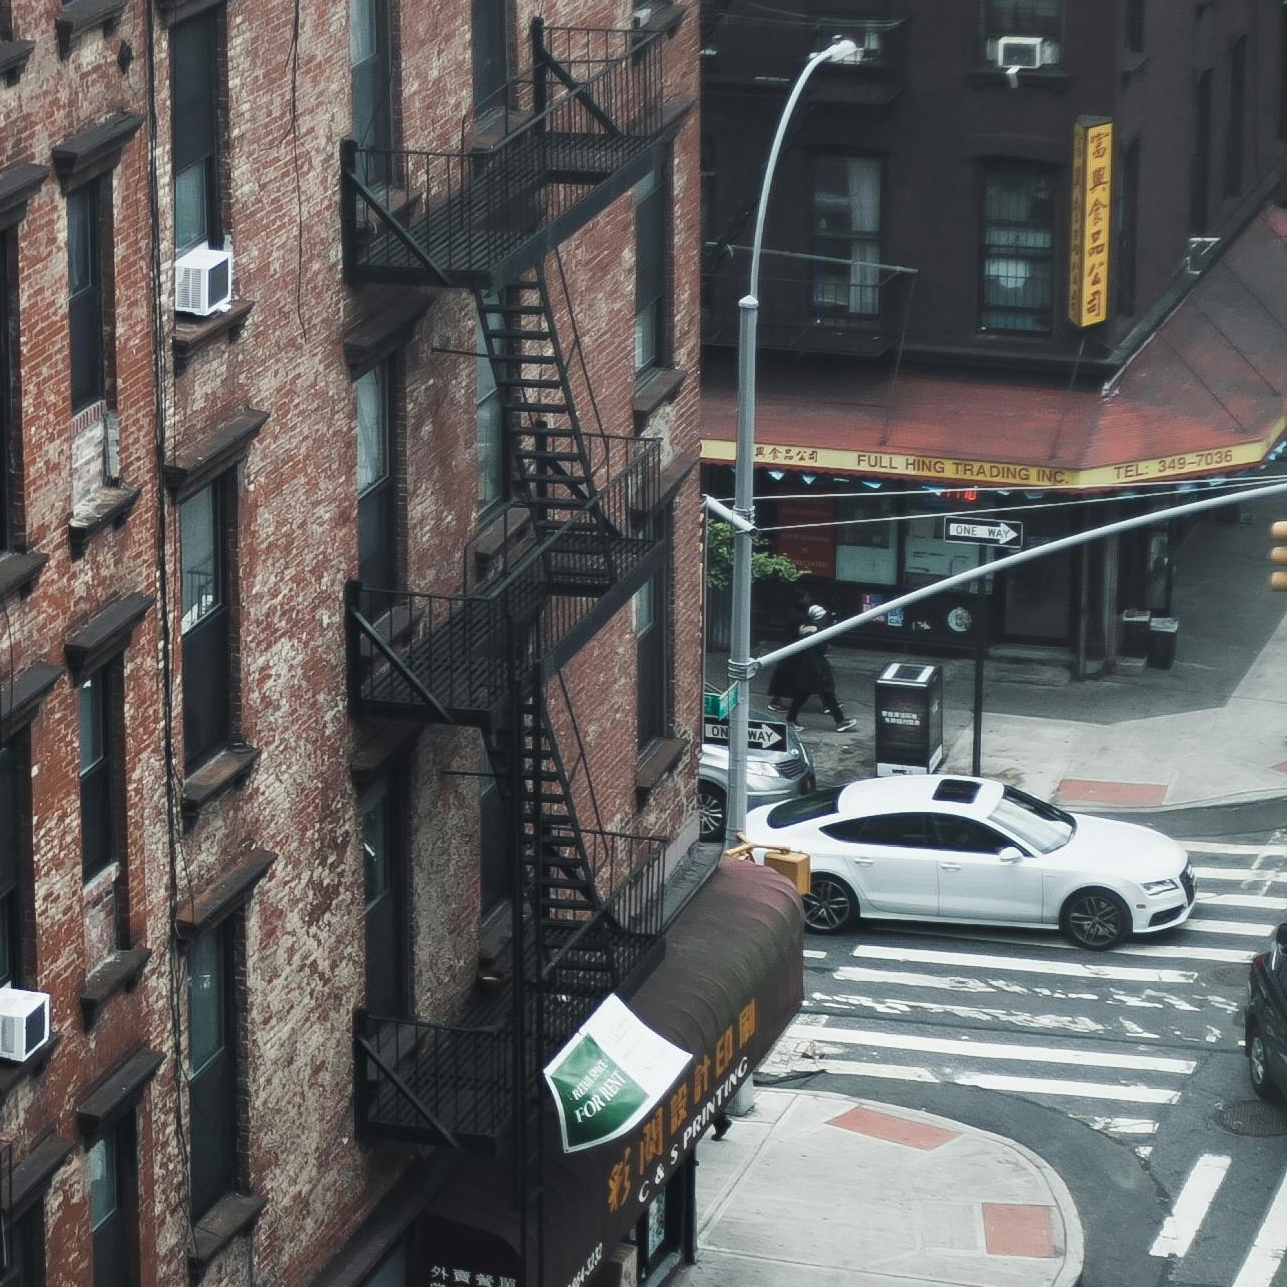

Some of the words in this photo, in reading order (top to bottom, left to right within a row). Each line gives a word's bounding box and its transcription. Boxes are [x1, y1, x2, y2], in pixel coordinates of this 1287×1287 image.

[753, 446, 818, 463] 興食品公司
[857, 453, 898, 470] FULL
[905, 458, 945, 474] HING
[952, 461, 1030, 481] TRADING
[1036, 471, 1069, 484] INC.
[1114, 464, 1149, 480] TEL:
[1157, 449, 1233, 473] 349-7036
[955, 524, 978, 537] ONE
[987, 528, 1010, 539] WAY
[712, 724, 729, 737] ON
[748, 726, 774, 743] WAY
[575, 1094, 606, 1123] FOR
[599, 1069, 626, 1101] RENT
[638, 1180, 649, 1203] C
[654, 1163, 665, 1185] &
[670, 1143, 679, 1165] S
[683, 1056, 748, 1150] PRINTING
